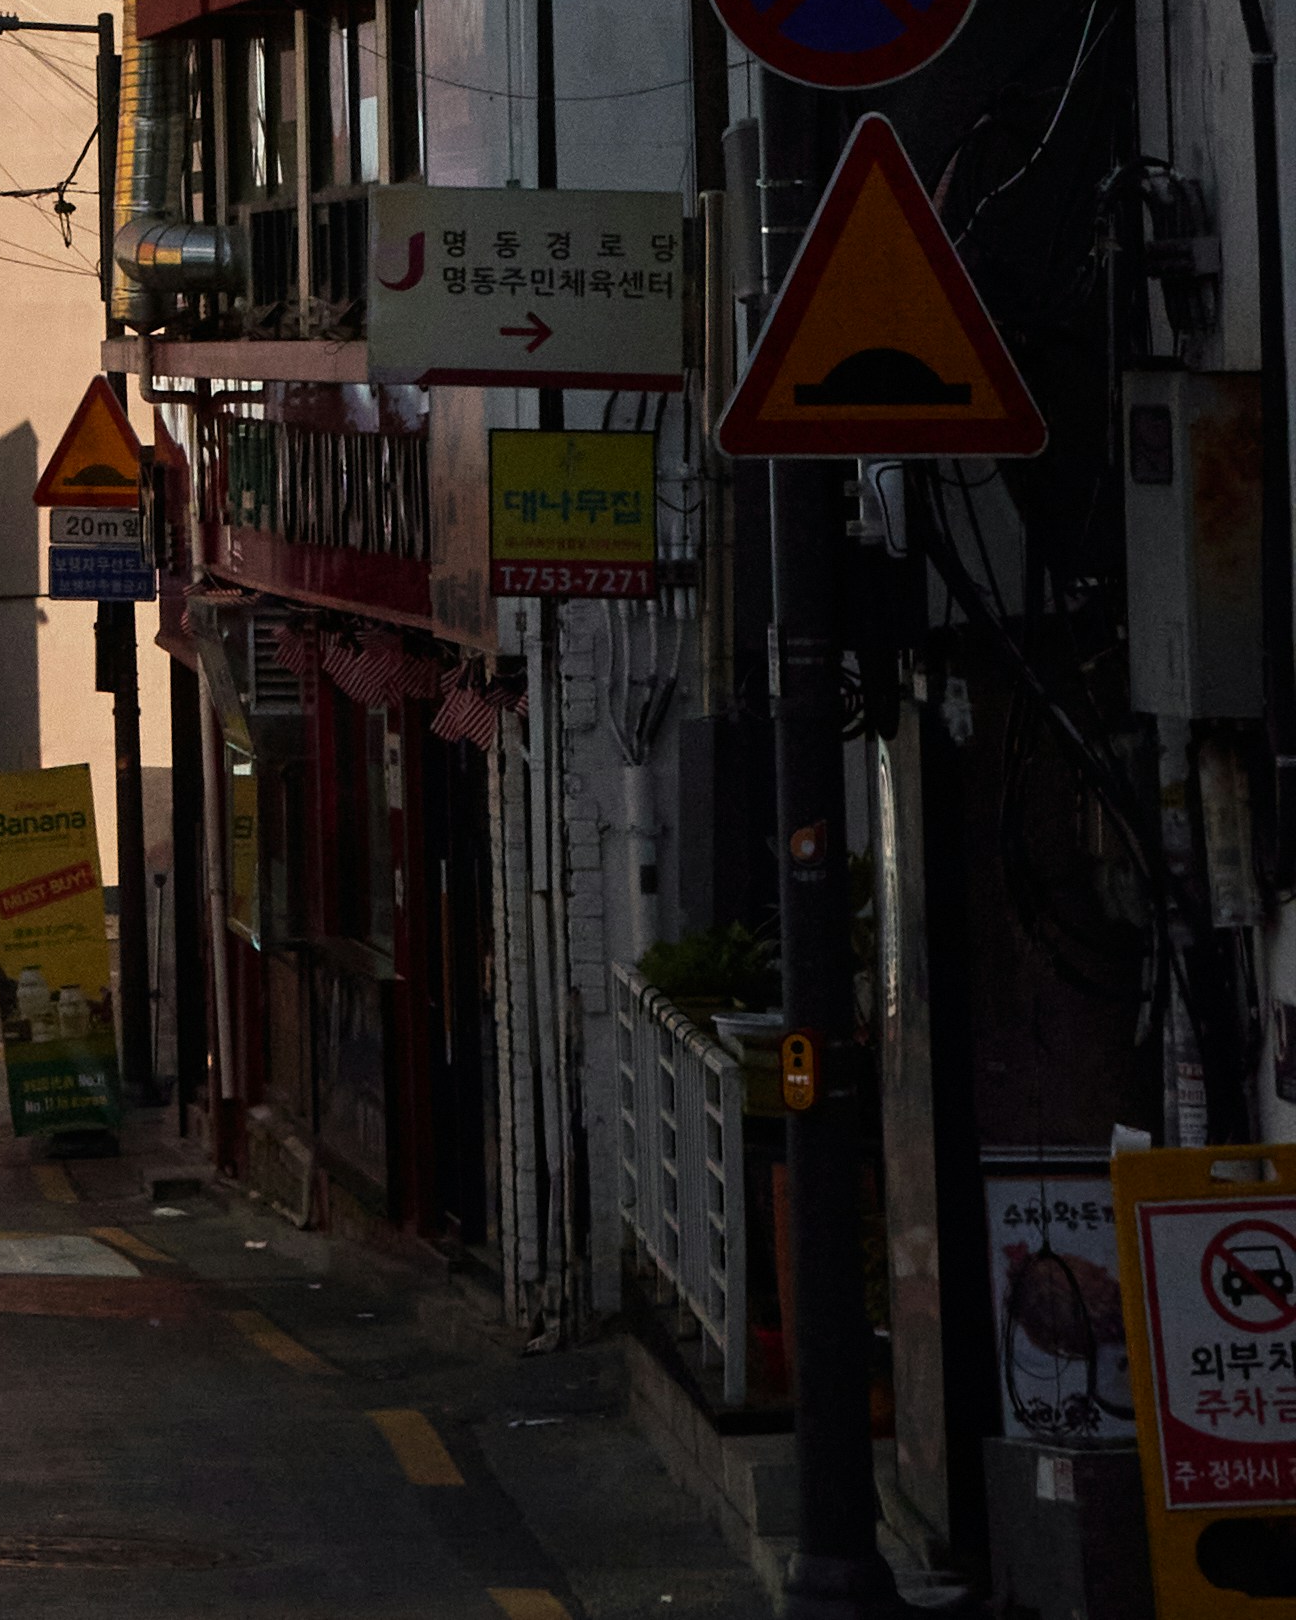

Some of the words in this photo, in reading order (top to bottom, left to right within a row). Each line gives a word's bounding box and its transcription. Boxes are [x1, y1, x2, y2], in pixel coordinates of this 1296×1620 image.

[443, 266, 675, 300] 명동주민체육센터
[504, 489, 641, 525] 대나무집
[66, 515, 118, 537] 20m
[500, 565, 649, 593] T.753-7271
[2, 883, 46, 911] MUST
